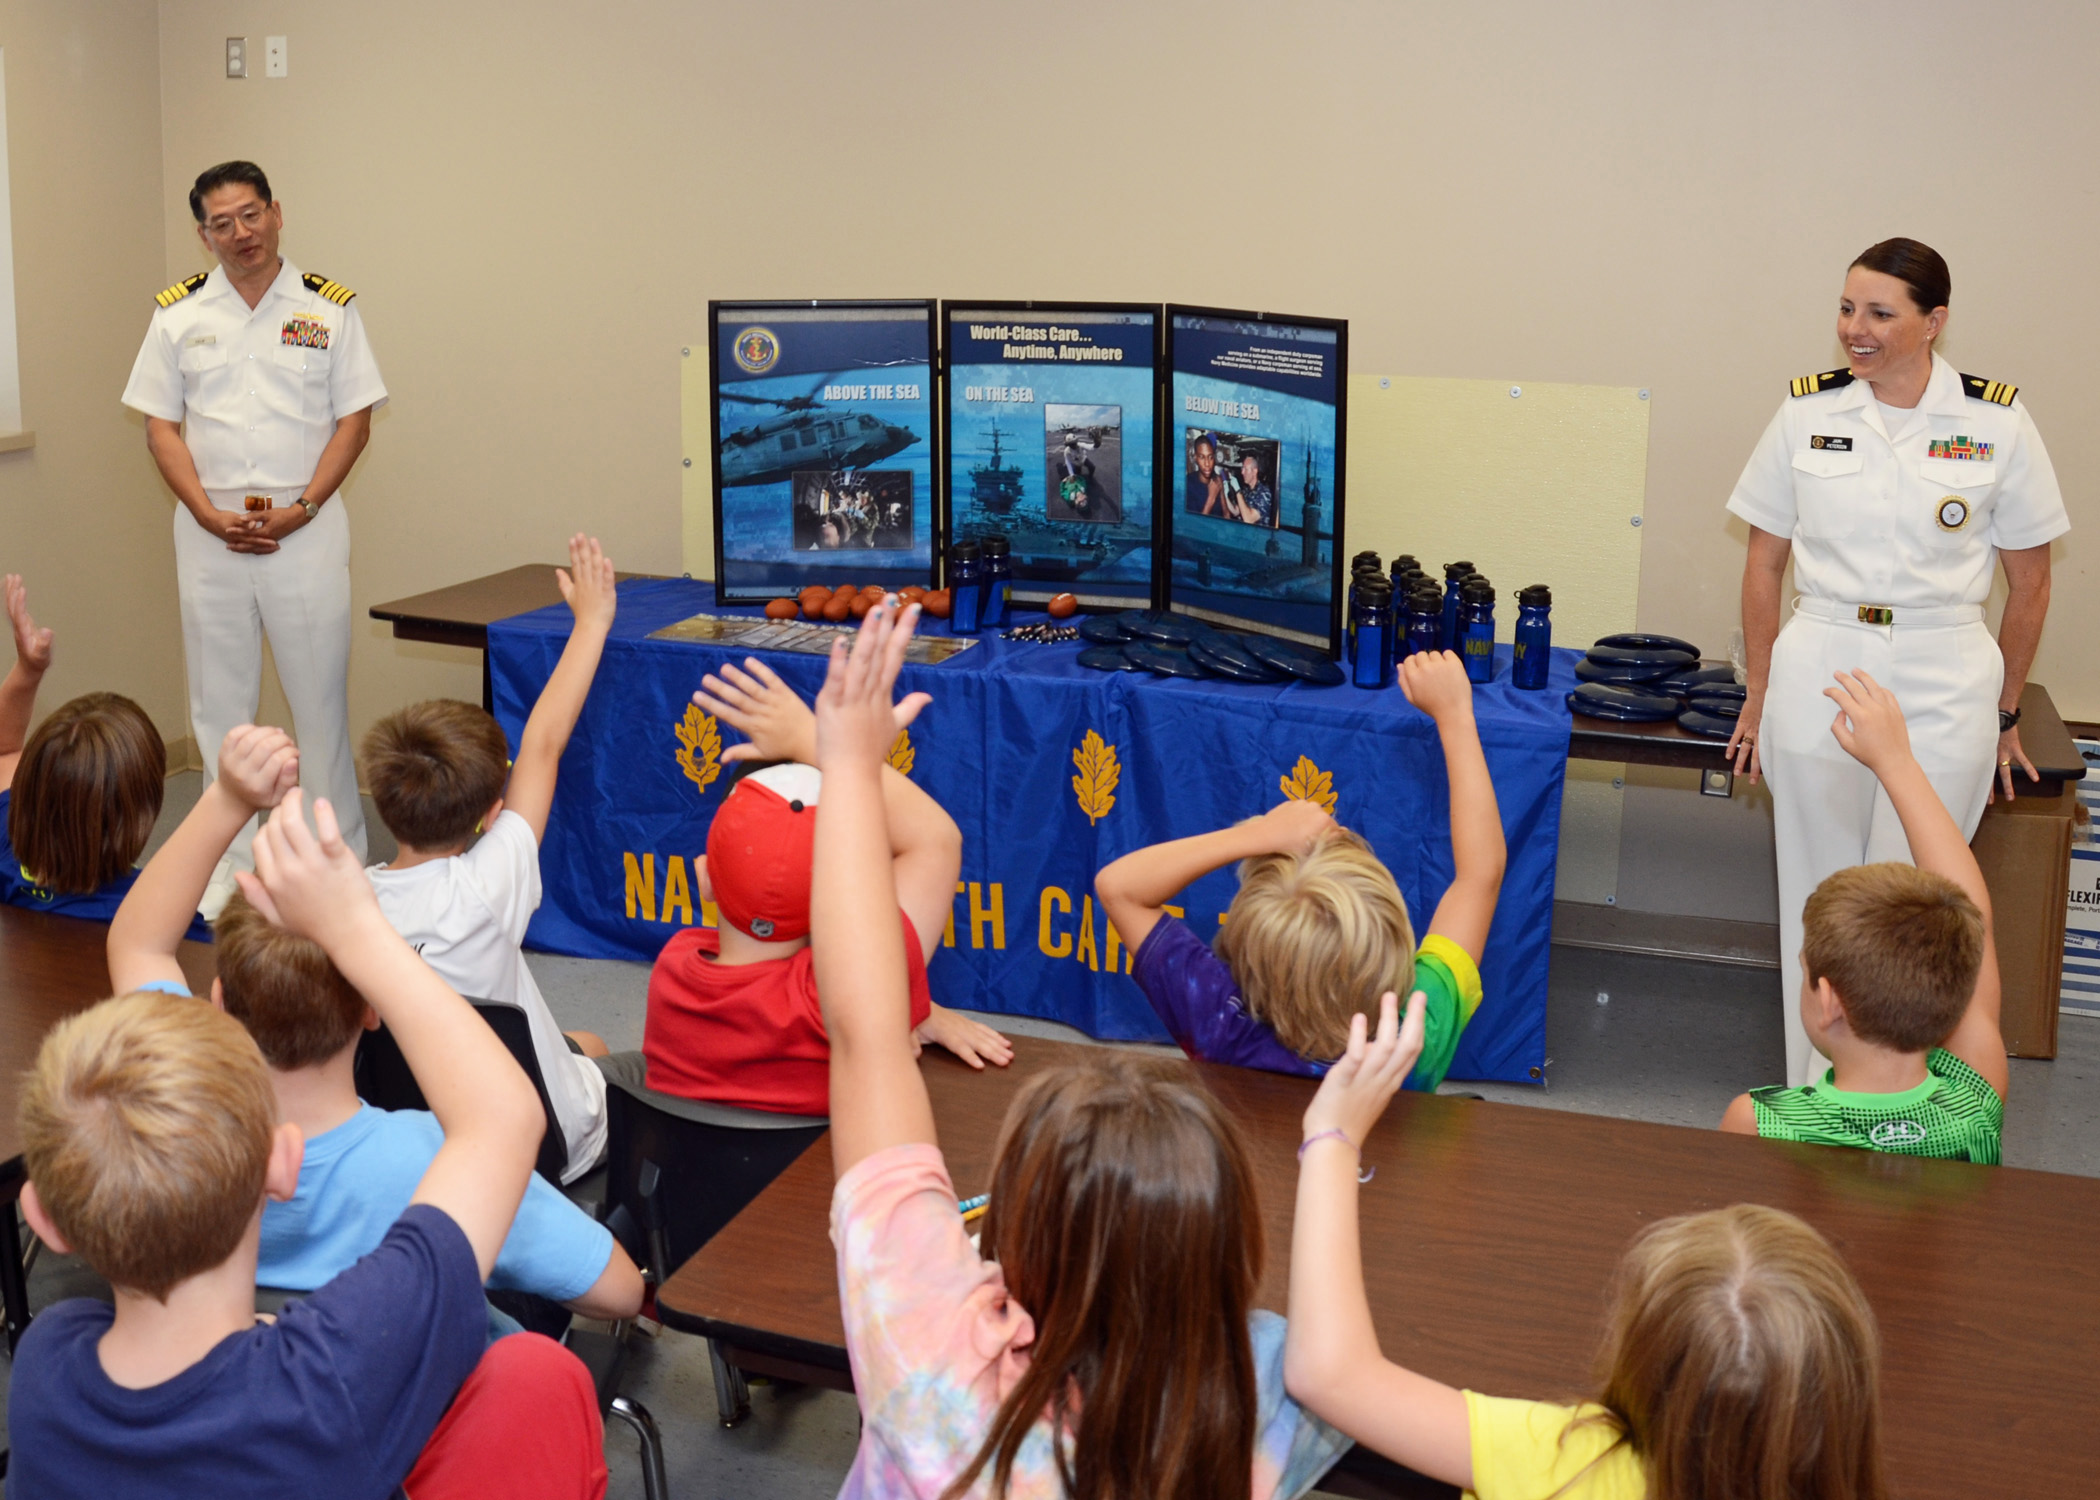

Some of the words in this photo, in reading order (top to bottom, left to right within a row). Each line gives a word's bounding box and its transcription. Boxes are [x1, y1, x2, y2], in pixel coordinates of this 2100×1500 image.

[970, 325, 1047, 341] World-Class
[1049, 326, 1092, 342] Care...
[1003, 343, 1057, 360] Anytime,
[1059, 345, 1123, 361] Anywhere
[824, 384, 867, 401] ABOVE
[869, 384, 893, 400] THE
[895, 384, 921, 400] SEA
[965, 386, 983, 401] ON
[985, 387, 1009, 402] THE
[1010, 387, 1034, 403] SEA
[1185, 395, 1219, 416] BELOW
[1221, 400, 1240, 418] THE
[1241, 403, 1260, 422] SEA
[623, 851, 718, 928] NAV
